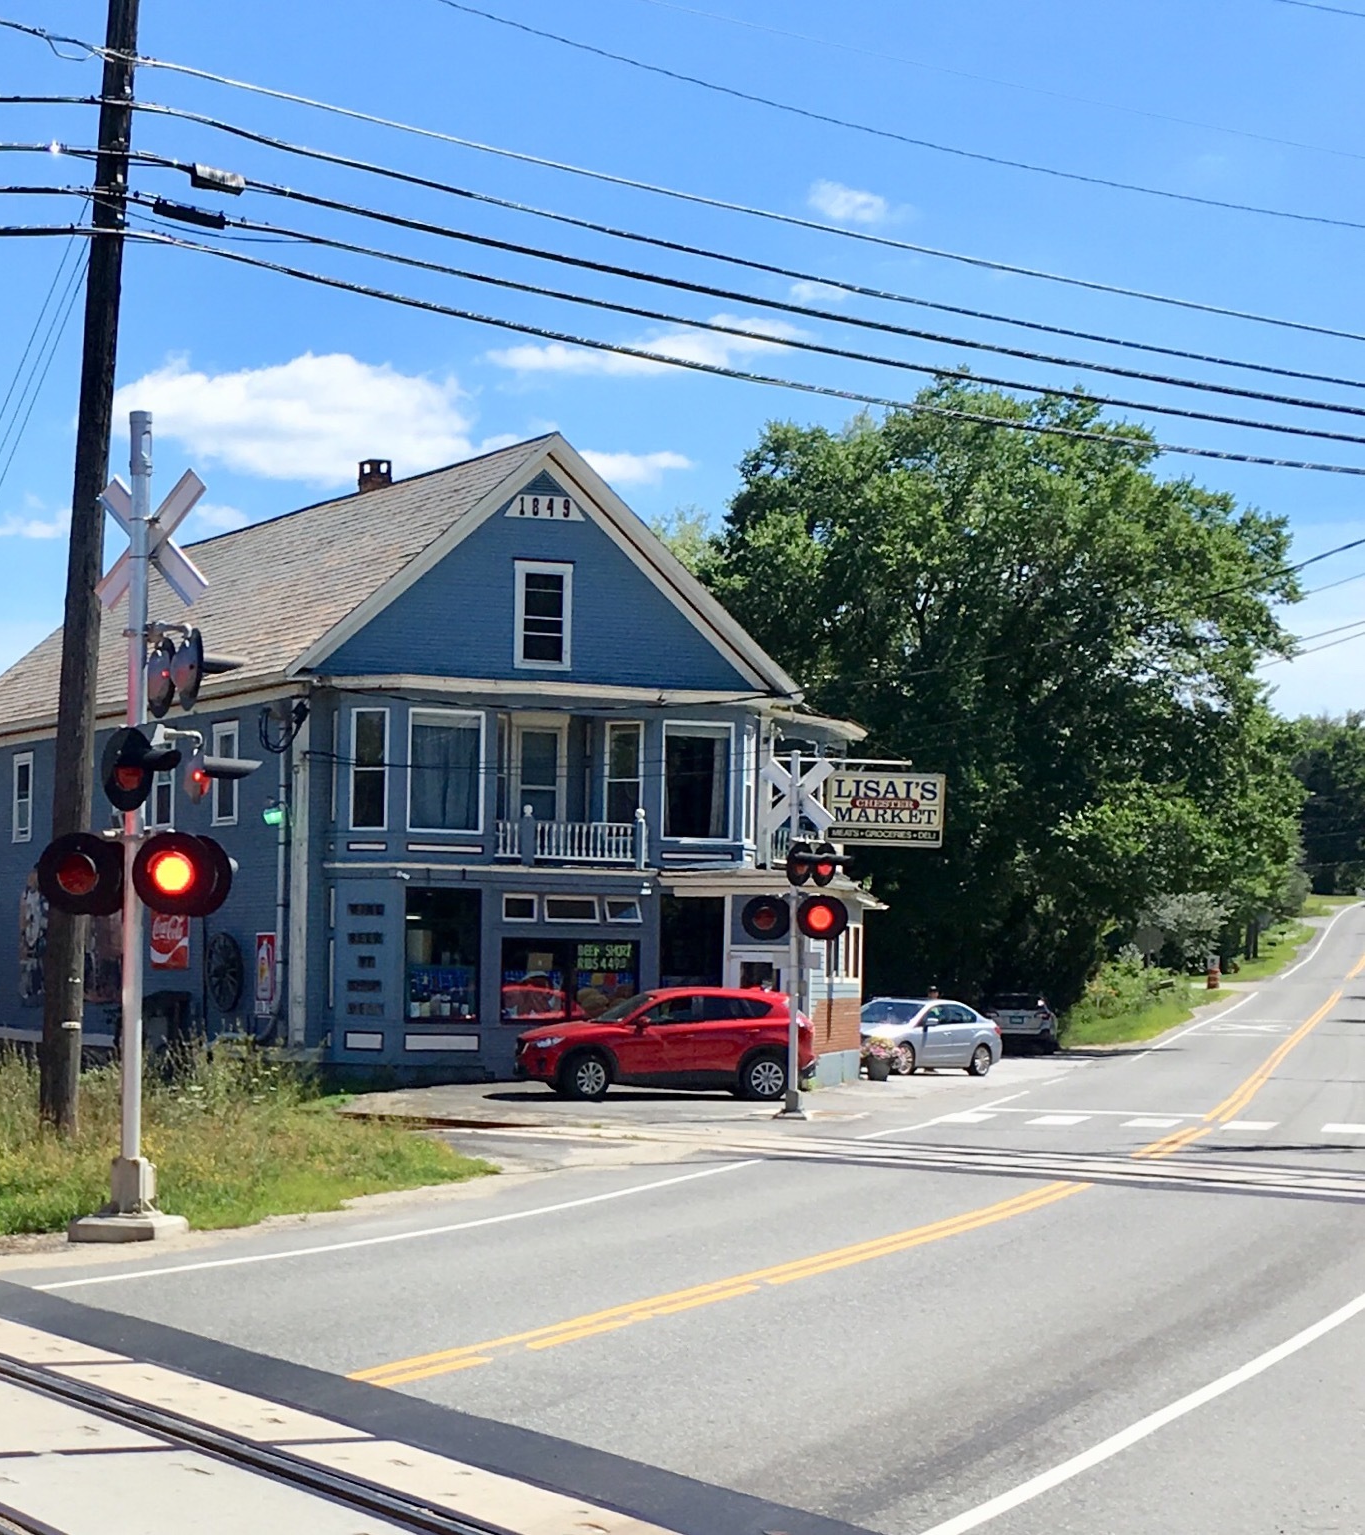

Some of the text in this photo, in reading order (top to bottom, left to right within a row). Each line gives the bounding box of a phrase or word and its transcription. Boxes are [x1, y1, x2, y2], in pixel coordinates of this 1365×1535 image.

[519, 496, 571, 518] 1849
[834, 779, 937, 801] LISAI'S
[855, 800, 915, 809] CHESTER
[834, 806, 937, 825] MARKET
[865, 829, 912, 839] GROCERIES
[917, 831, 936, 840] DELI
